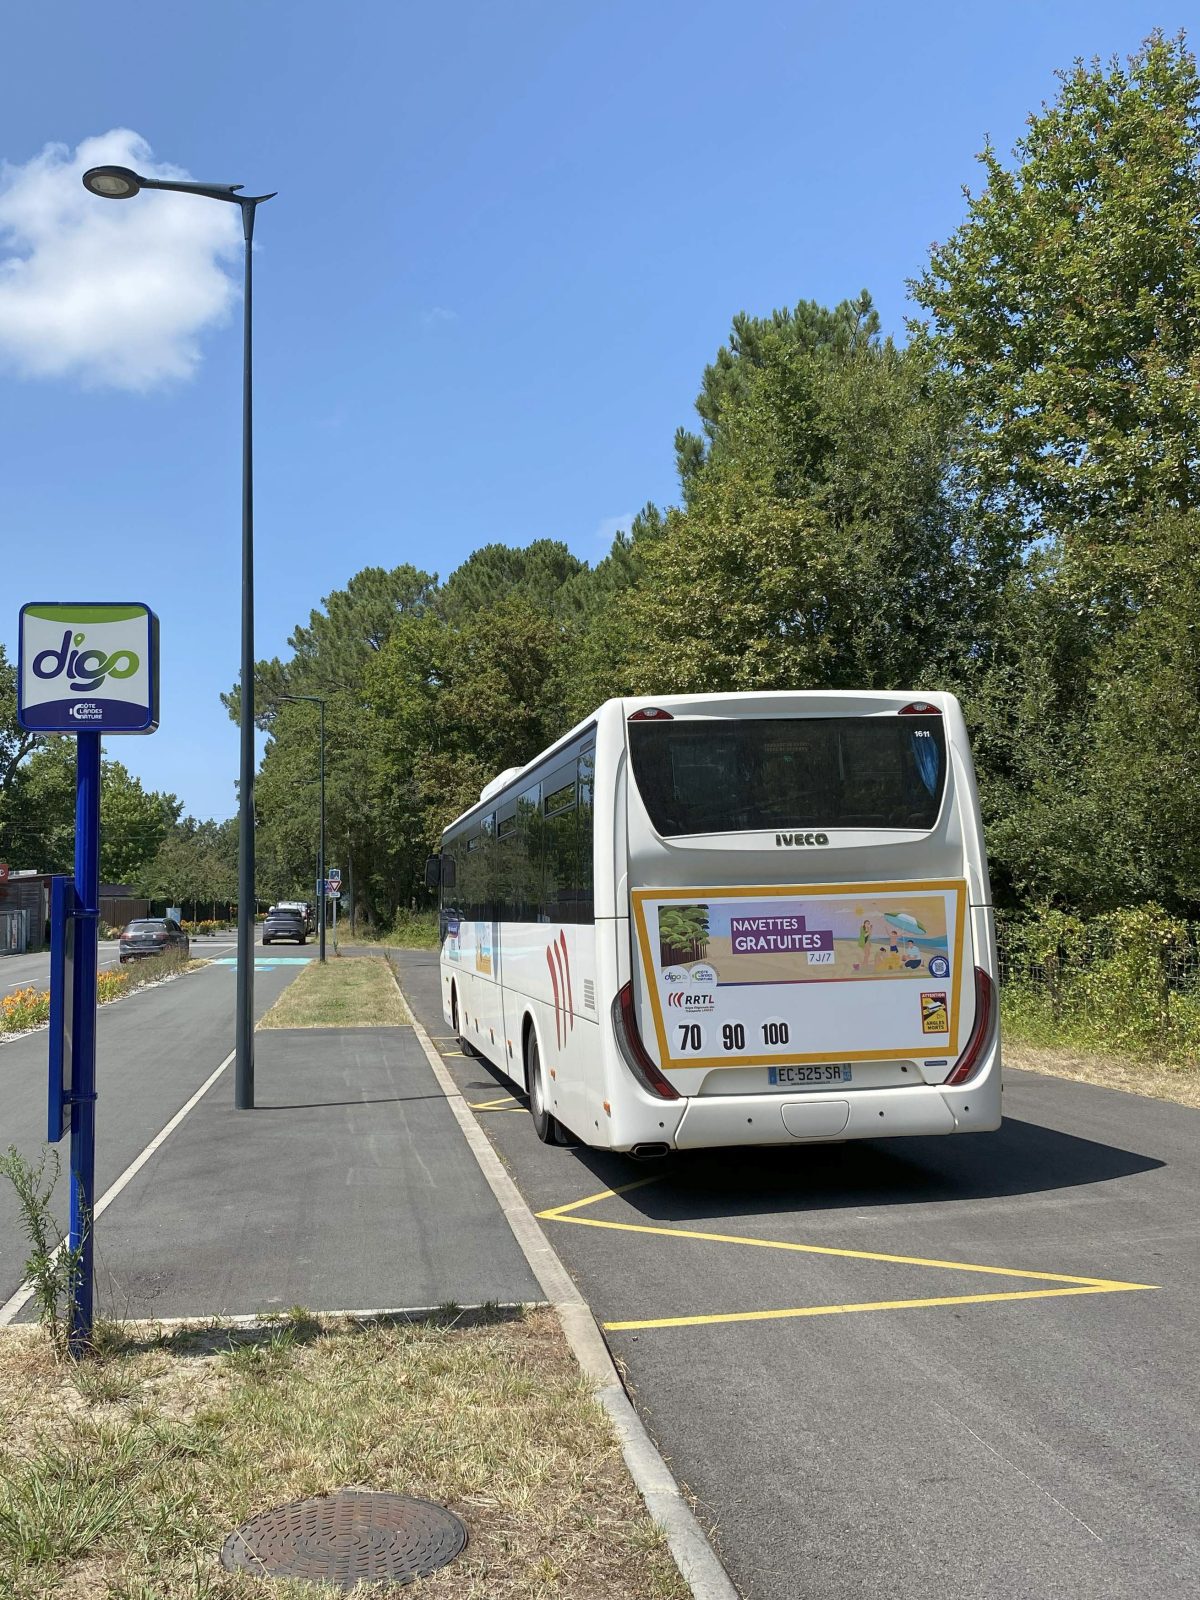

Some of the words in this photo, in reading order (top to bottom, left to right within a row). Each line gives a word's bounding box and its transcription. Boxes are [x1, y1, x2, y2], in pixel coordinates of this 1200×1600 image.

[32, 630, 140, 692] digo
[914, 730, 930, 738] 1611
[775, 833, 830, 847] IVECO
[733, 918, 798, 932] NAVETTES
[735, 934, 822, 951] GRATUITES
[809, 952, 832, 963] 7J/7
[685, 994, 715, 1005] RRTL
[678, 1023, 702, 1051] 70
[722, 1023, 745, 1051] 90
[761, 1022, 790, 1045] 100
